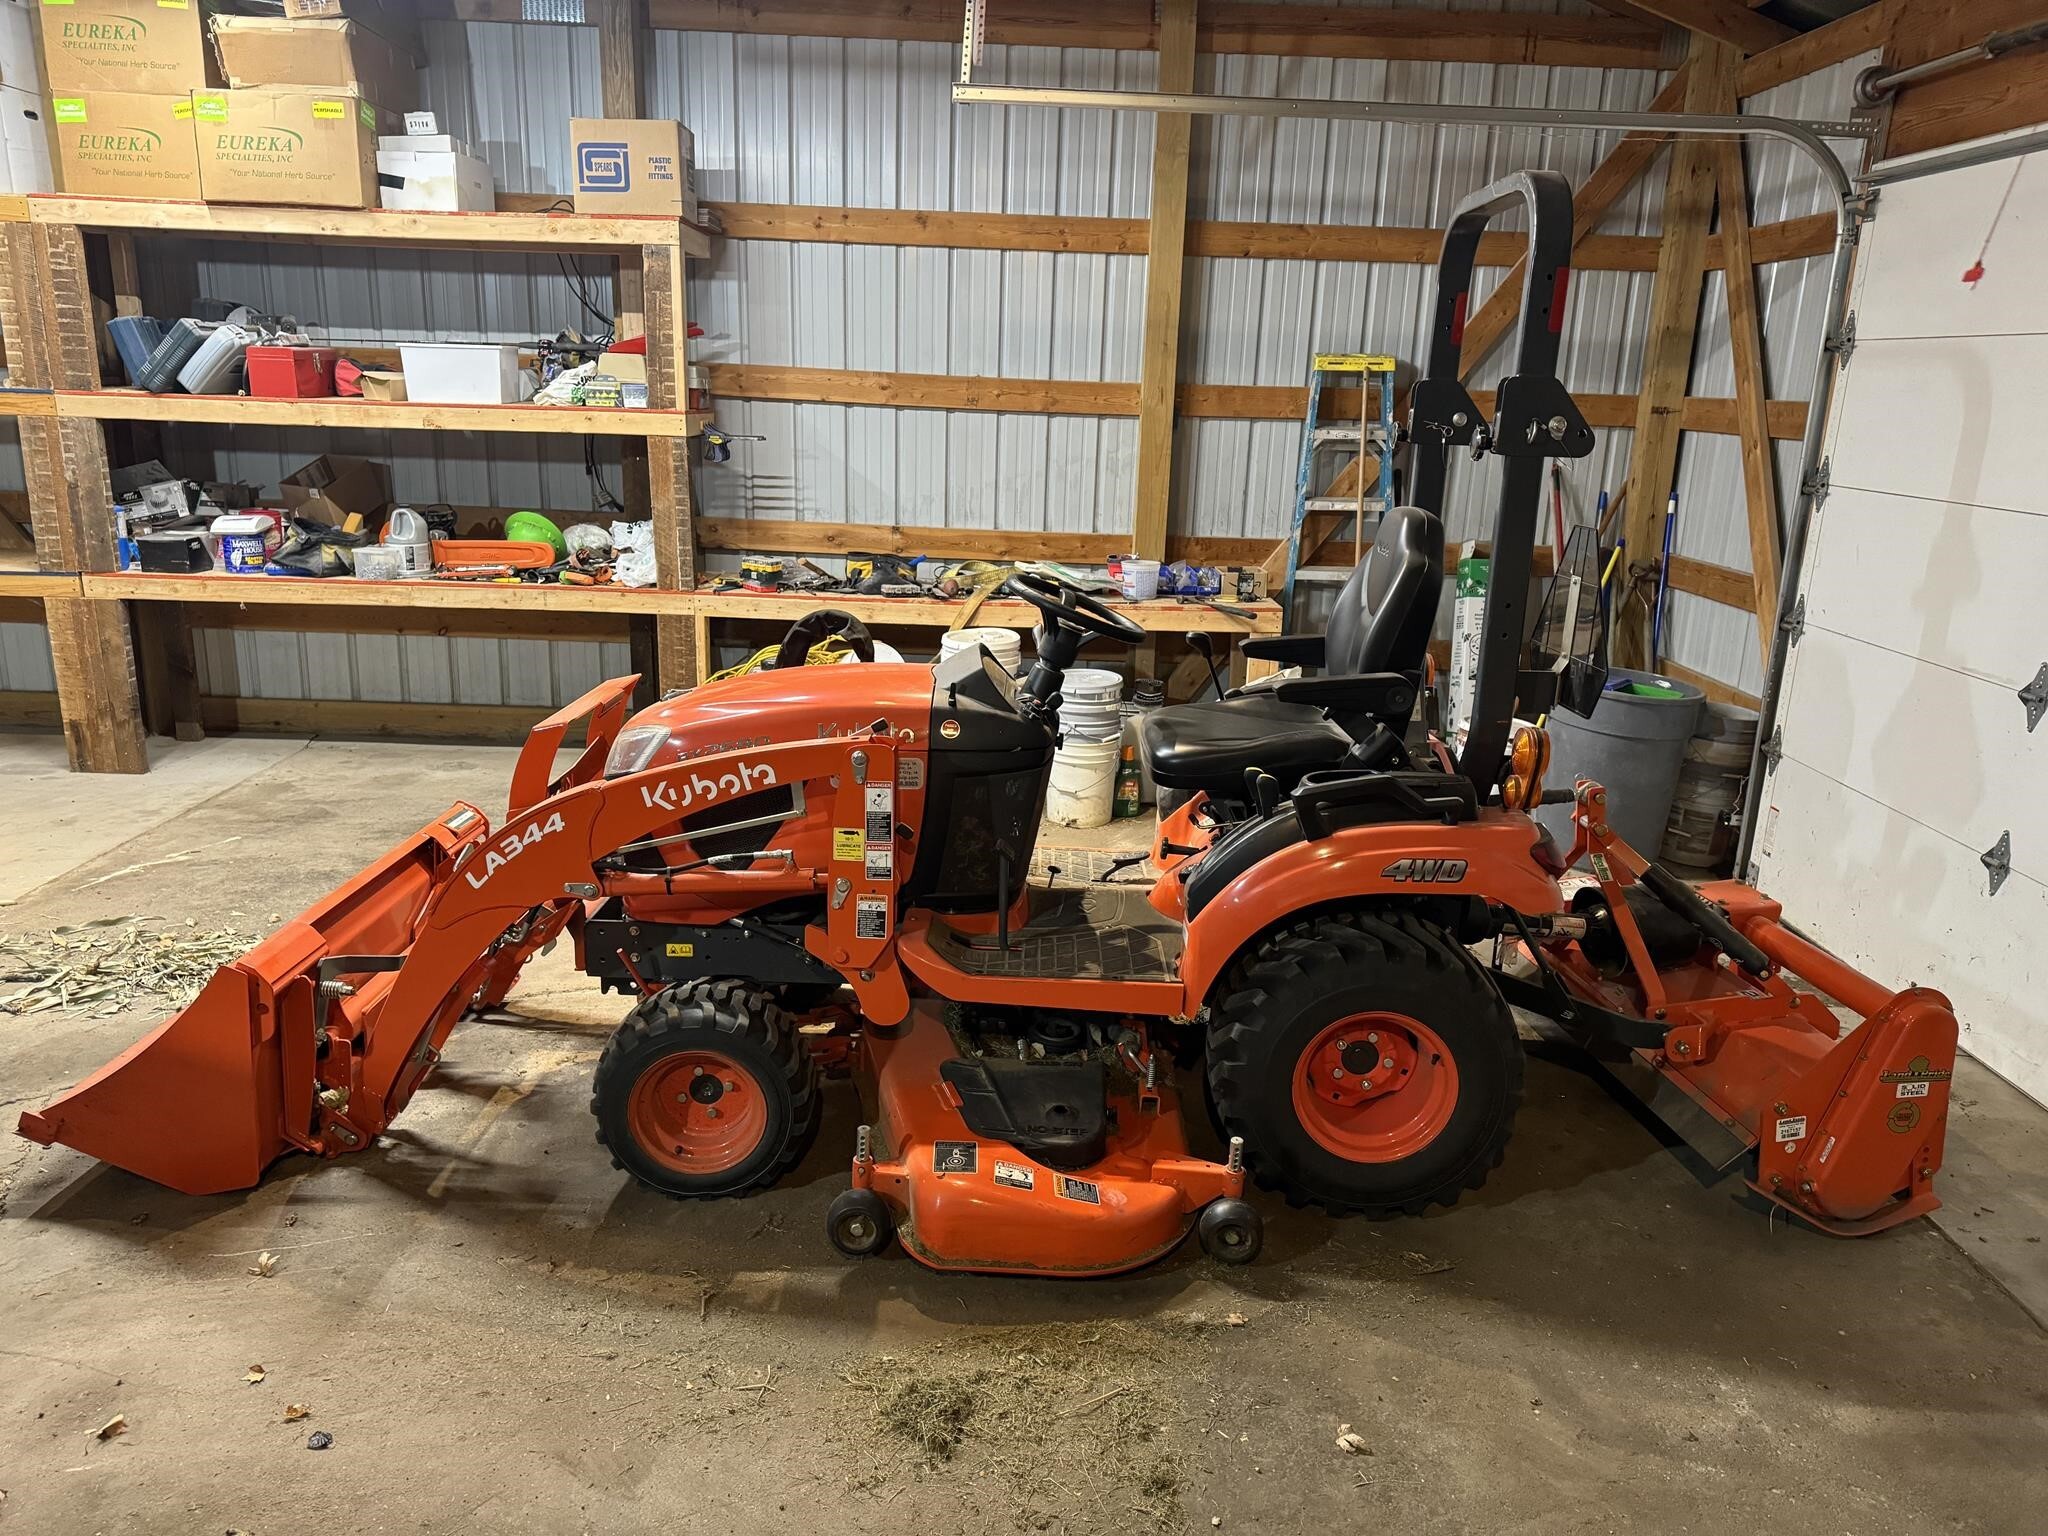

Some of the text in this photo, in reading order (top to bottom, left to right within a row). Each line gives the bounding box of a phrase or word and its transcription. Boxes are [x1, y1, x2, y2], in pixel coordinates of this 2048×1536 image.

[63, 22, 137, 40] EUREKA
[62, 41, 137, 52] SPECIALTIES, INC
[98, 58, 128, 68] National
[130, 60, 148, 69] Herb
[78, 134, 152, 152] EUREKA
[216, 135, 293, 152] EUREKA
[78, 152, 152, 163] SPECIALTIES, INC
[216, 152, 293, 163] SPECIALTIES, INC
[648, 157, 672, 165] PLASTIC
[594, 162, 613, 172] SPEARS
[113, 168, 142, 177] National
[145, 169, 163, 178] Herb
[252, 169, 283, 179] National
[285, 170, 303, 180] Herb
[232, 539, 262, 548] MAXWELL
[640, 761, 777, 811] Kubota
[465, 811, 566, 890] LA344
[1381, 859, 1469, 883] 4WD
[1053, 1126, 1088, 1135] STEP
[1004, 1162, 1033, 1174] DANGER
